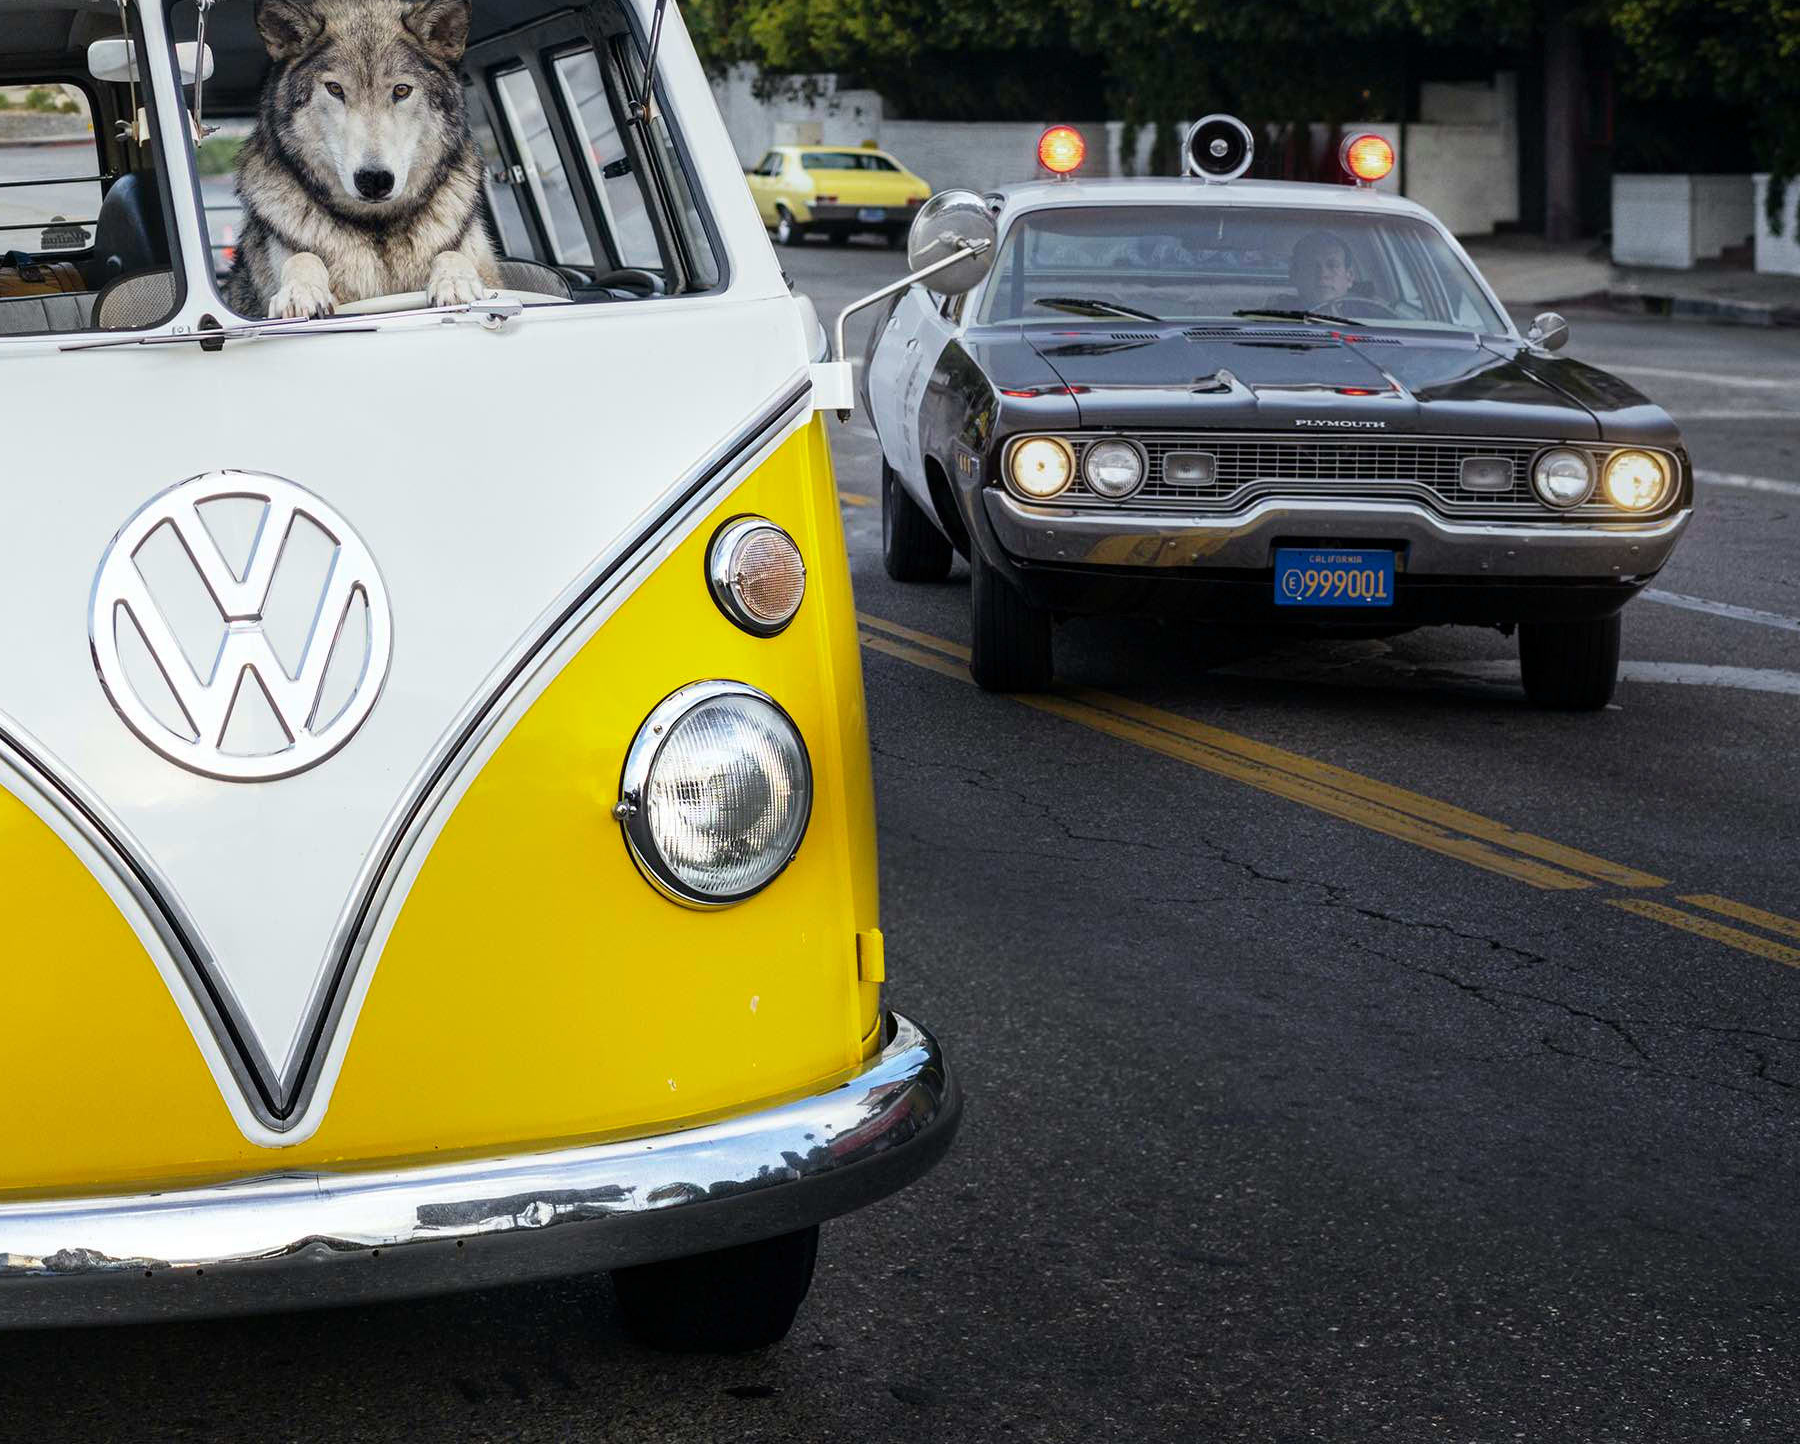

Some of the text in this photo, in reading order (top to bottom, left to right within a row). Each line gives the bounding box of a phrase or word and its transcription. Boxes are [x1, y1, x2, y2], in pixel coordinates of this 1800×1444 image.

[1295, 420, 1385, 428] PLYMOUTH
[1308, 555, 1363, 564] CALIFORNIA
[96, 478, 386, 774] VW
